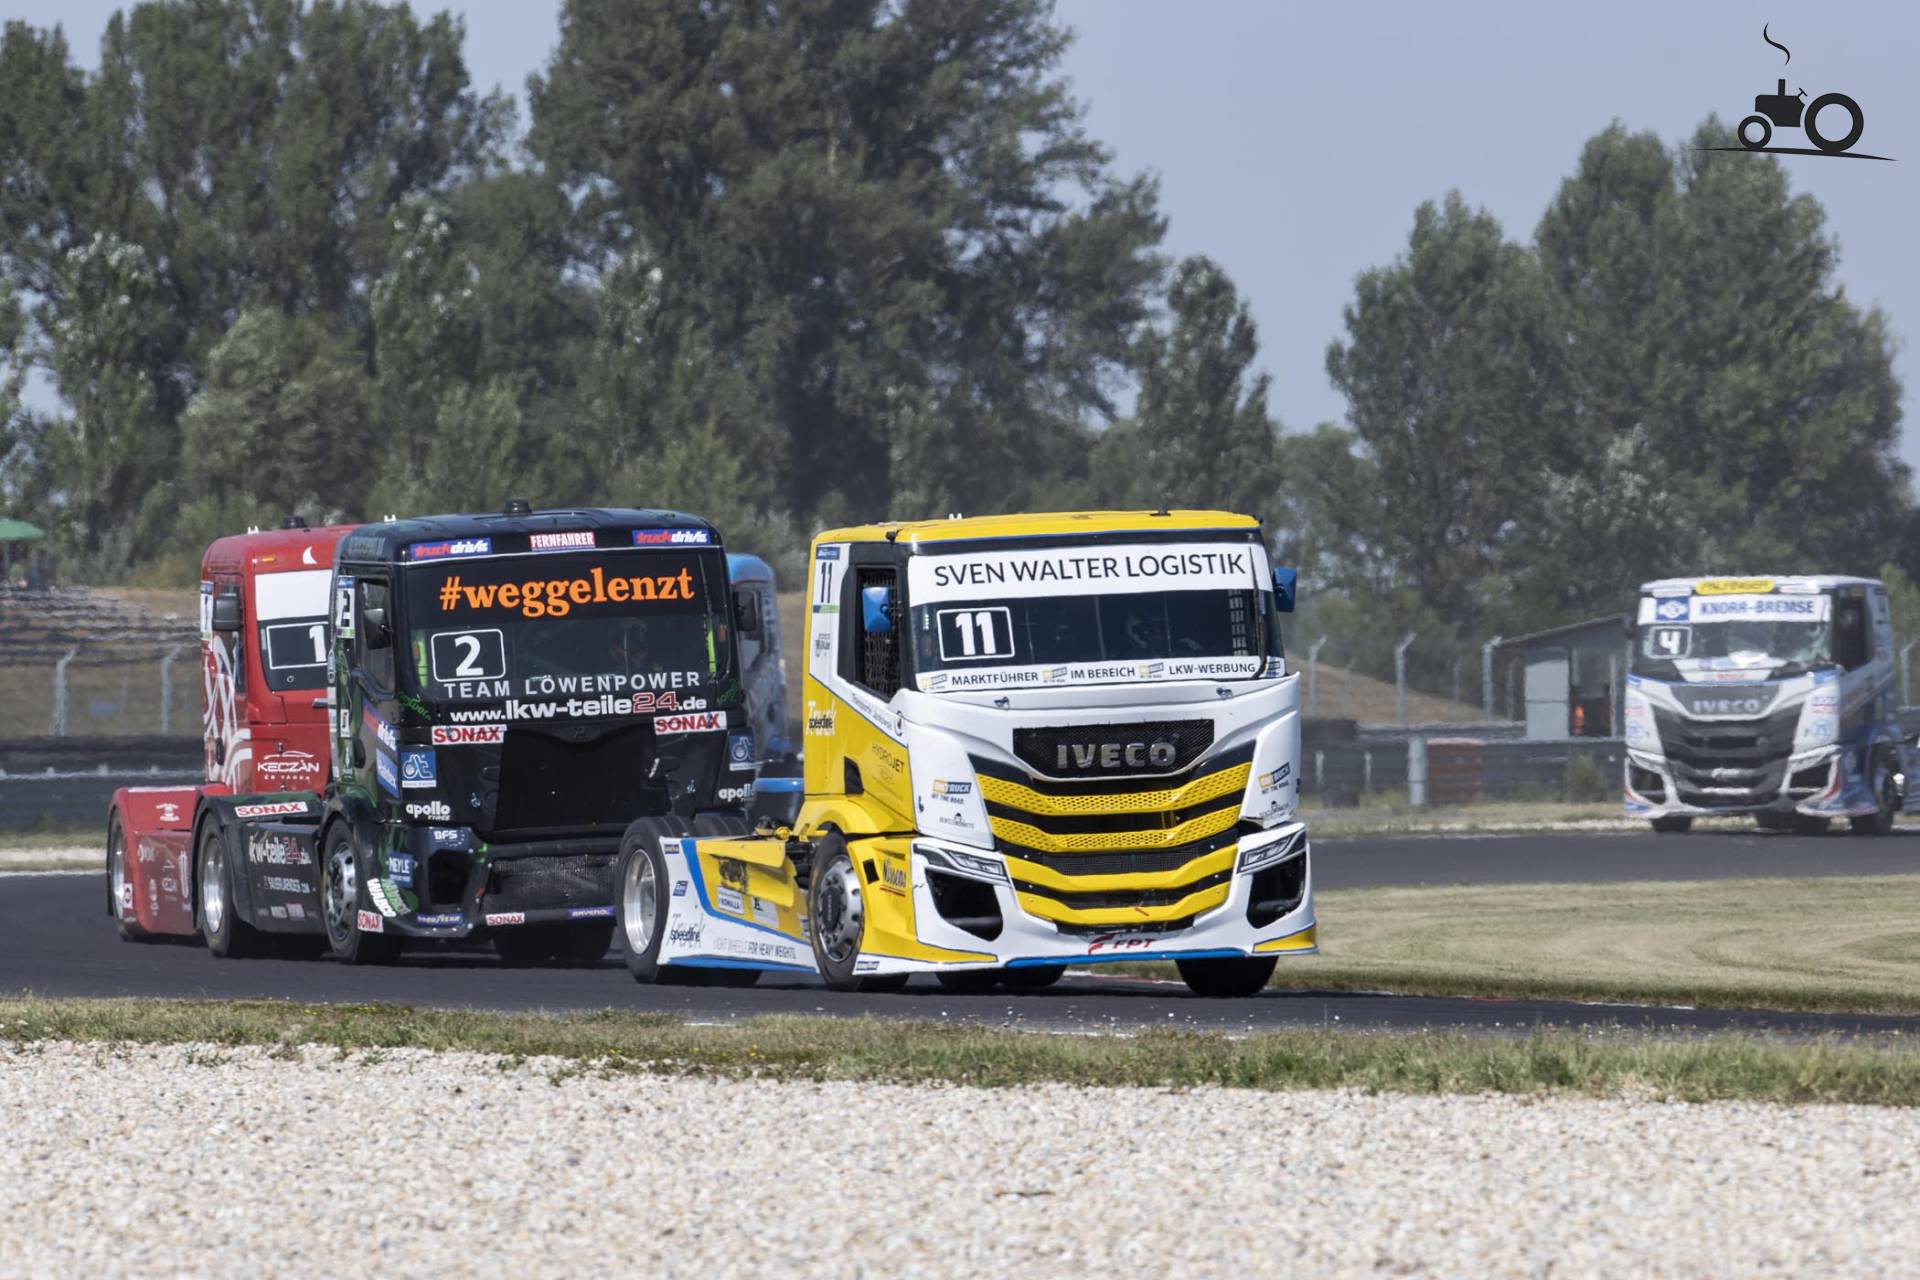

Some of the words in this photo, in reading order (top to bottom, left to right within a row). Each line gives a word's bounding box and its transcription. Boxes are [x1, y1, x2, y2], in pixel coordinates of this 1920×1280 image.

[530, 532, 595, 548] FERNFAHRER
[934, 562, 1005, 587] SVEN
[1010, 558, 1120, 582] WALTER
[1126, 553, 1246, 577] LOGISTIK
[440, 566, 695, 618] #weggelenzt
[821, 562, 833, 604] 11
[1700, 600, 1814, 615] KNORR-BREMSE
[955, 611, 997, 656] 11
[1660, 630, 1680, 655] 4
[454, 635, 484, 677] 2
[443, 680, 510, 698] TEAM
[525, 671, 700, 695] LÖWENPOWER
[951, 671, 1039, 686] MARKTFÜHRER
[1071, 668, 1085, 680] IM
[1089, 666, 1136, 679] BEREICH
[1169, 663, 1256, 675] LKW-WERBUNG
[450, 691, 707, 722] www.lkw-teile24.de
[1692, 699, 1758, 713] IVECO
[656, 713, 721, 733] SONAX
[434, 727, 500, 743] SONAX
[1057, 743, 1177, 769] IVECO
[237, 803, 302, 817] SONAX
[406, 801, 451, 818] apollo
[434, 830, 458, 840] BFS
[488, 914, 523, 925] SONAX
